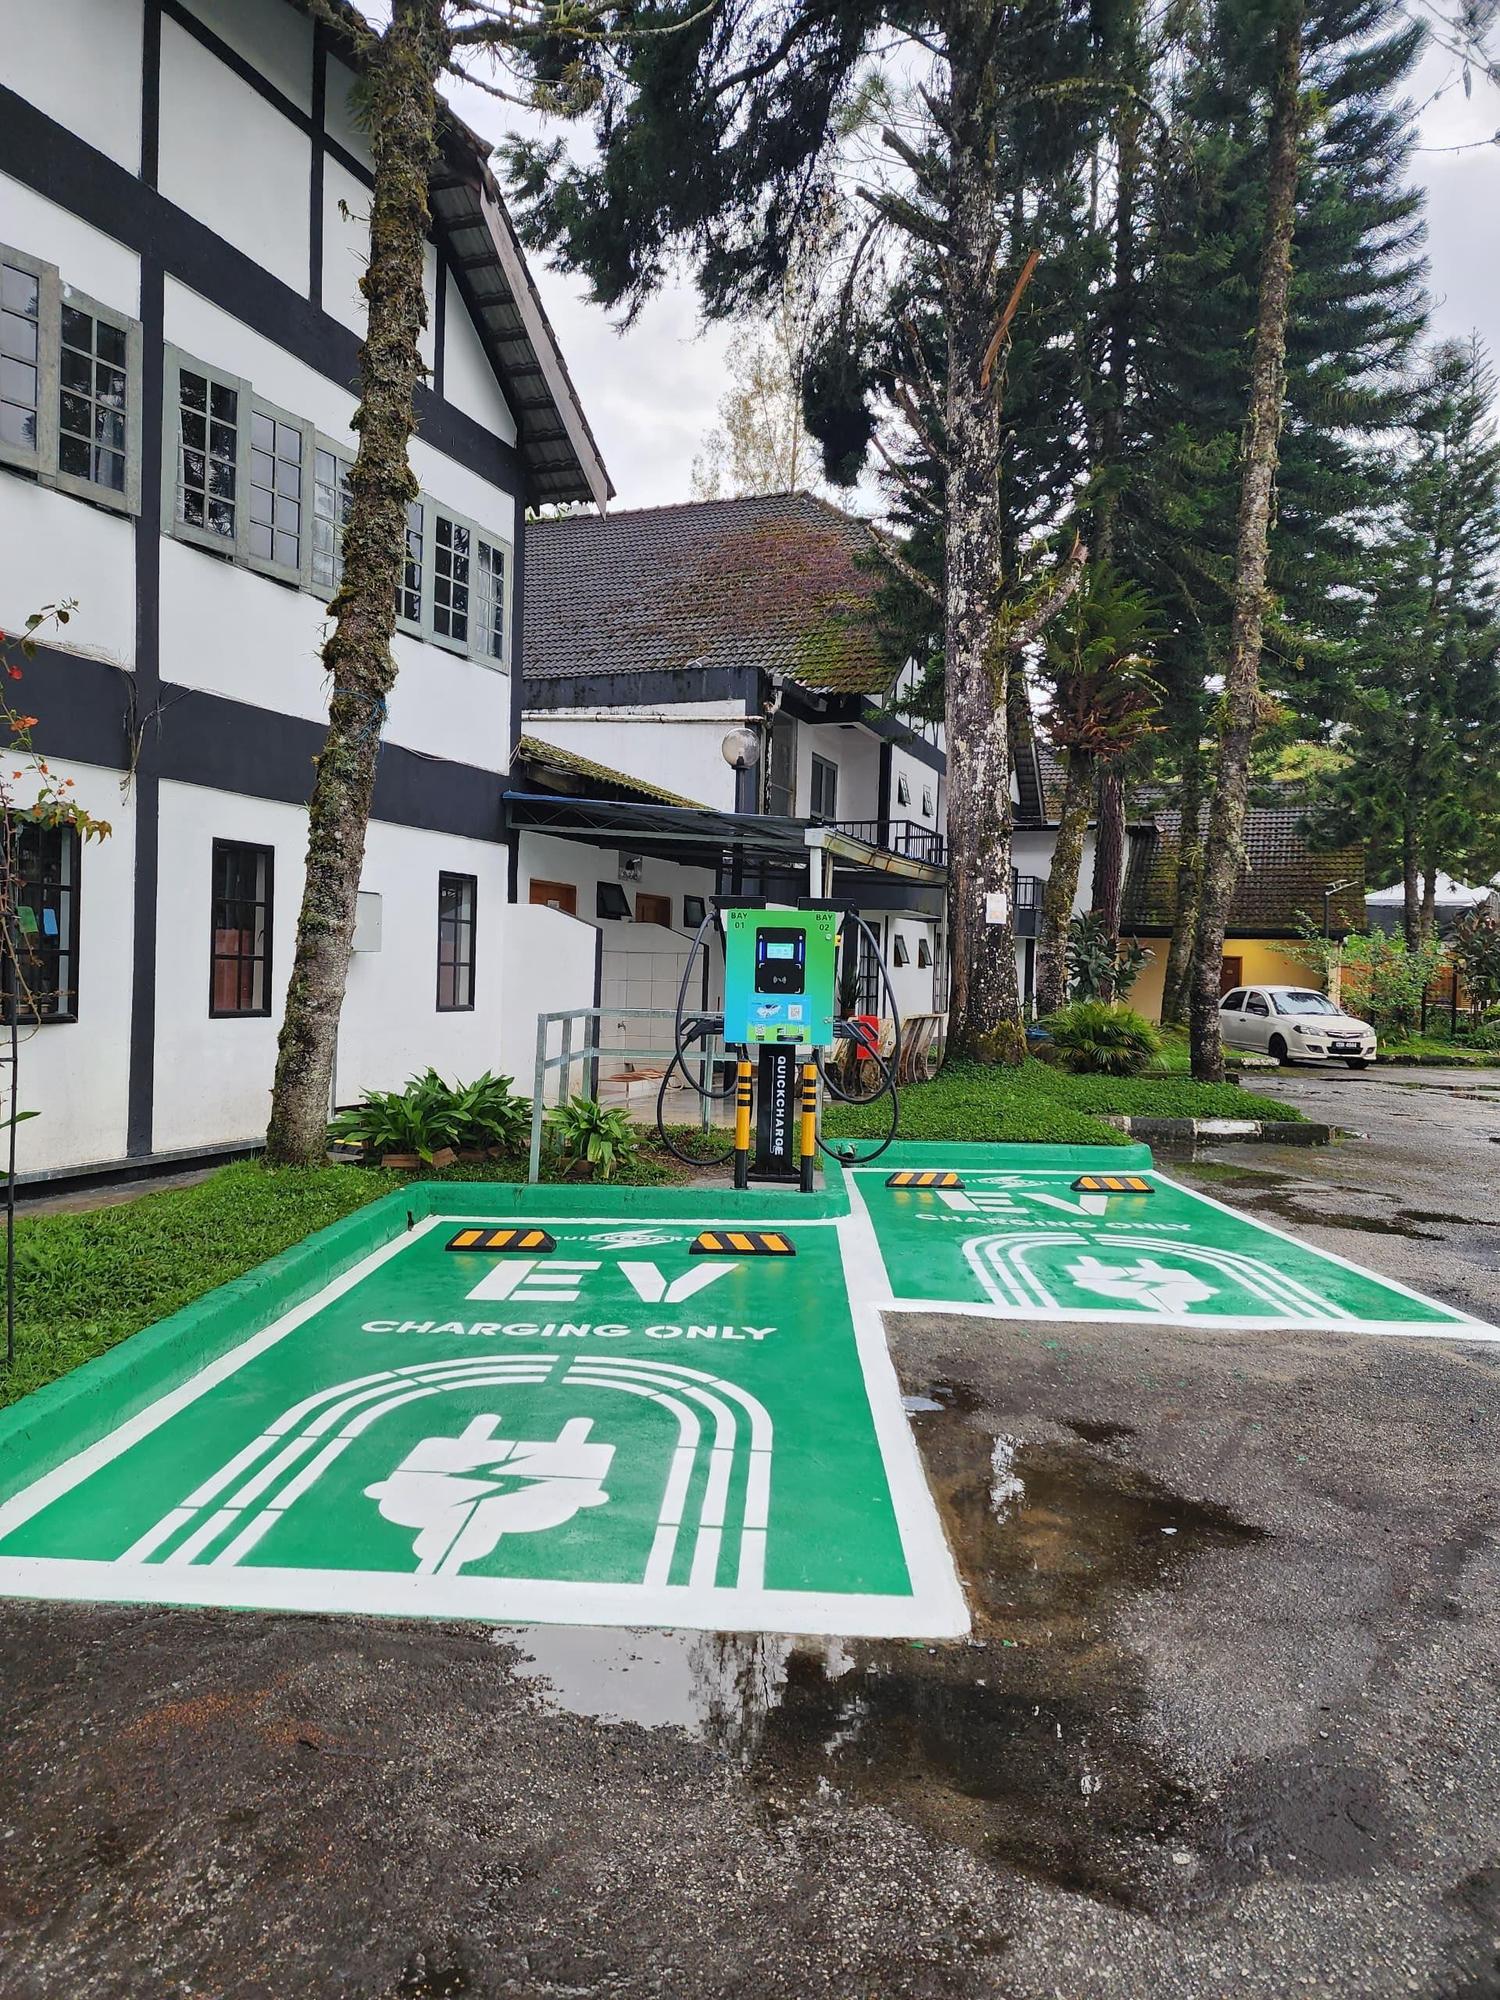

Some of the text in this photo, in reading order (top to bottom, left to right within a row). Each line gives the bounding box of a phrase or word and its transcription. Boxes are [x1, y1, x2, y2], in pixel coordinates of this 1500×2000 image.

[774, 1055, 787, 1156] QUICKCHARGE
[935, 1190, 1109, 1216] EV
[915, 1213, 1192, 1231] CHARGING ONLY
[464, 1259, 741, 1303] EV
[361, 1320, 777, 1340] CHARGING ONLY
